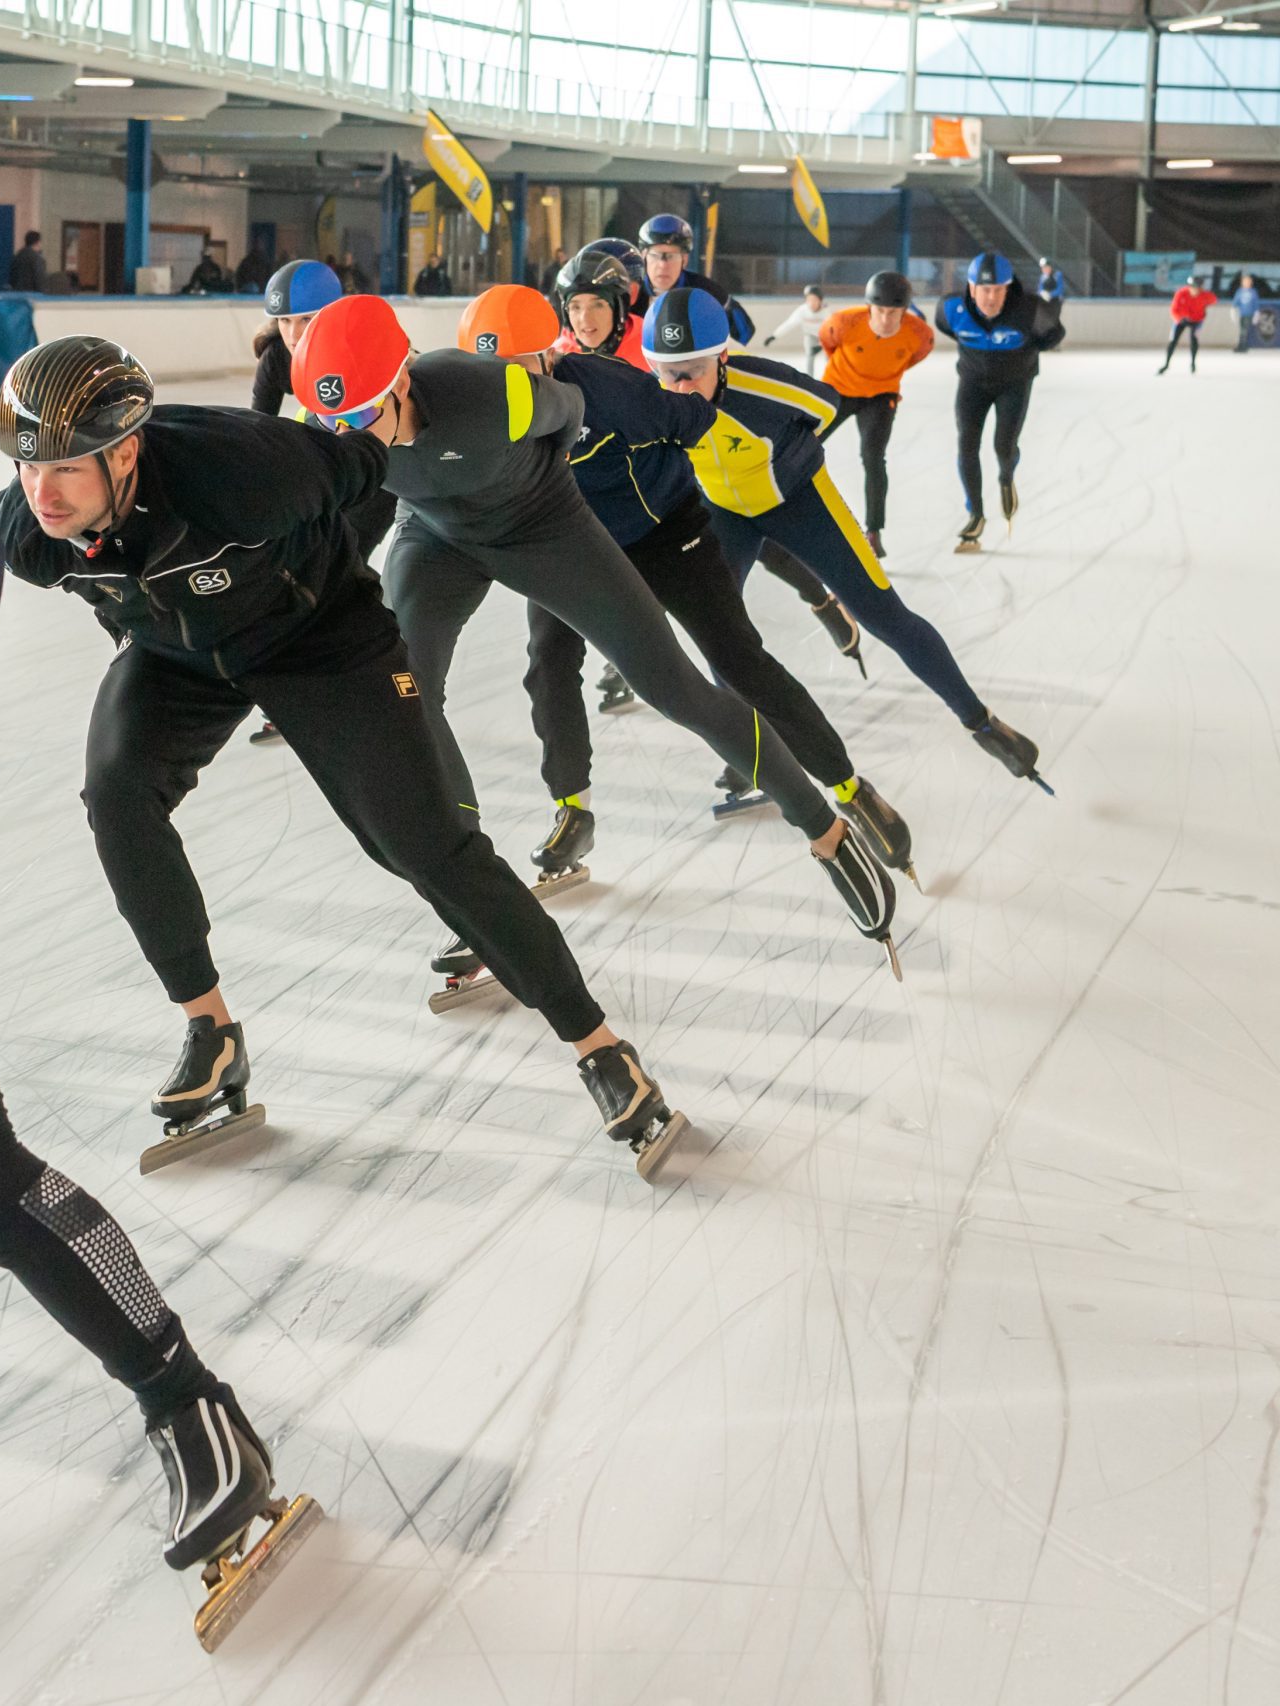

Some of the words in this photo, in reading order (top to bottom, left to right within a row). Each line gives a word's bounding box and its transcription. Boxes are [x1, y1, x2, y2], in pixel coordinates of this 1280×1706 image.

[664, 327, 681, 338] SK
[477, 336, 496, 349] SK
[319, 379, 341, 398] SK
[20, 436, 34, 448] SK
[195, 572, 225, 588] SK
